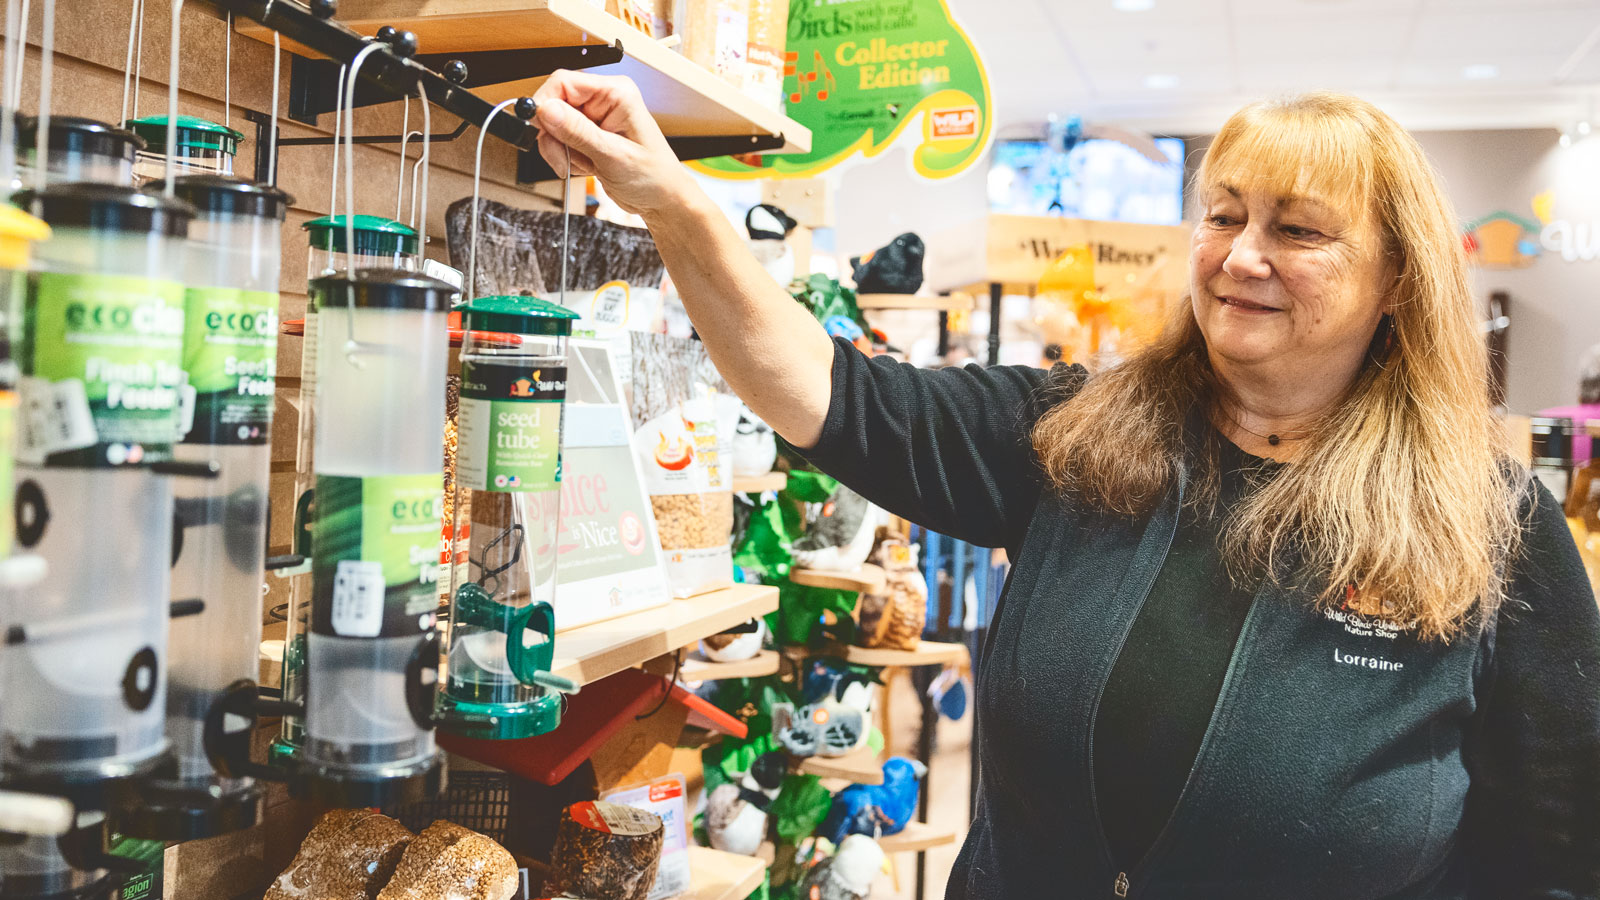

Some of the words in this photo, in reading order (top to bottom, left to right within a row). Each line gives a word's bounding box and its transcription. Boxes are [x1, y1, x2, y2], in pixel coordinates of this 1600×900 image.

[835, 38, 949, 67] Collector
[859, 62, 950, 90] Edition
[933, 111, 974, 127] WILD
[498, 408, 541, 428] seed
[497, 429, 540, 449] tube
[579, 520, 619, 549] Nice
[1324, 607, 1347, 623] Wild
[1344, 623, 1373, 637] Nature
[1375, 628, 1398, 639] Shop
[1334, 648, 1404, 672] Lorraine
